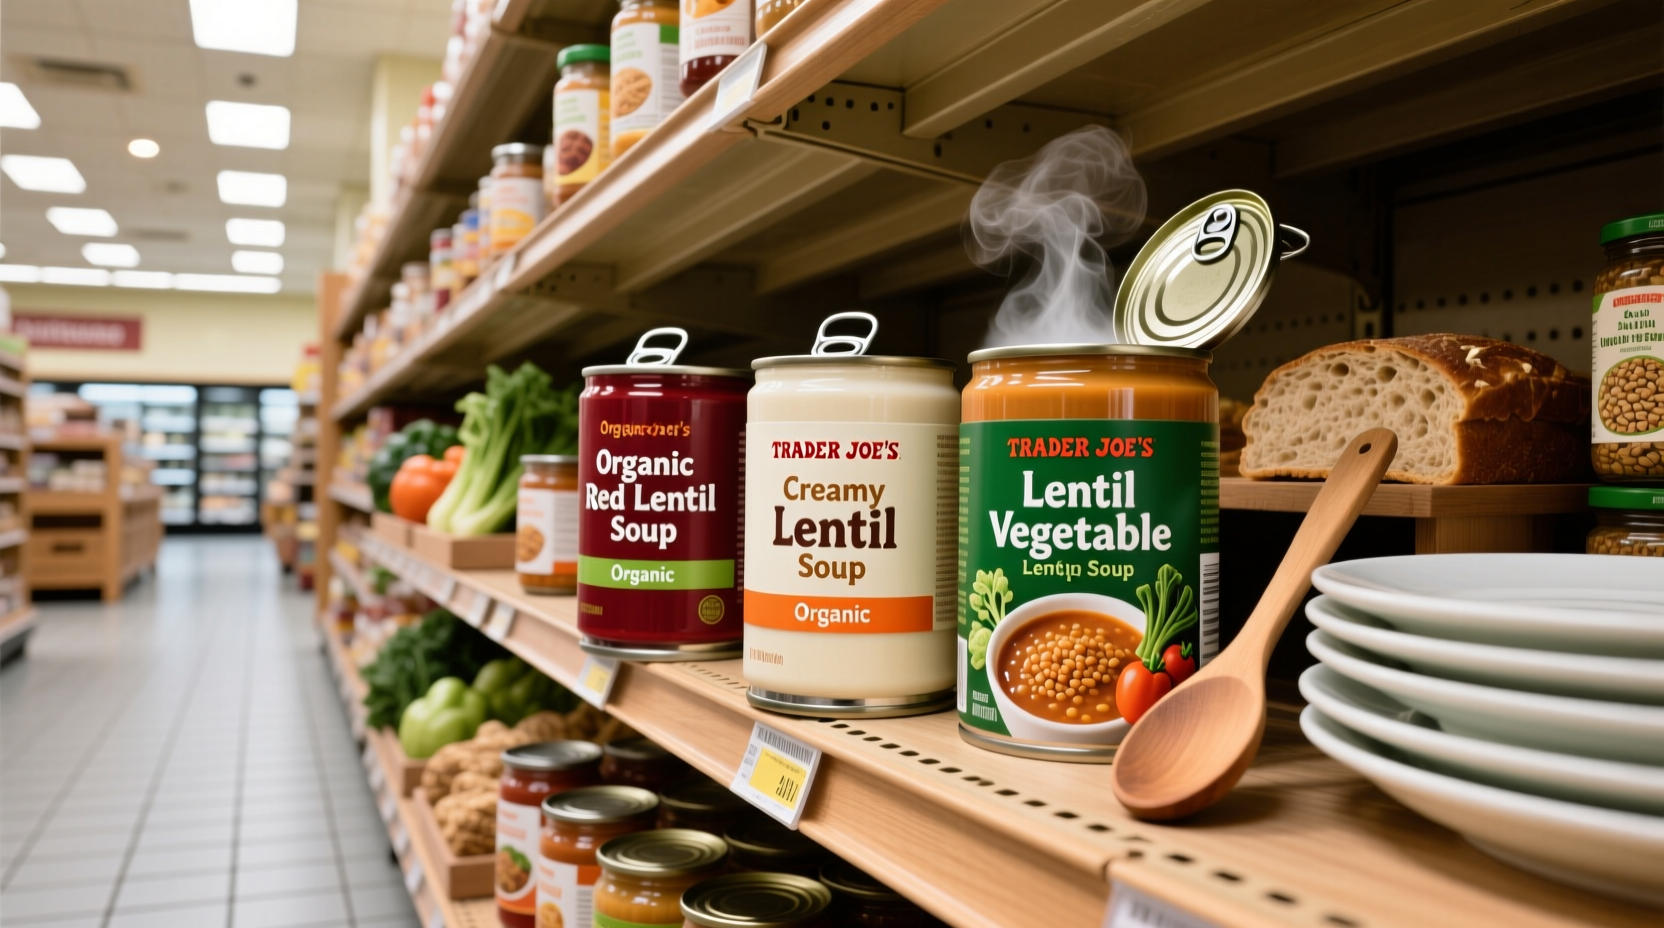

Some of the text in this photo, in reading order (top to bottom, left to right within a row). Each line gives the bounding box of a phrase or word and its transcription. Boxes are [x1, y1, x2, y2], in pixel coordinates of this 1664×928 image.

[771, 440, 899, 460] TRADER JOE'S
[1007, 437, 1154, 458] TRADER JOE'S
[596, 448, 694, 483] Organic
[585, 483, 716, 512] Red Lentil
[783, 475, 886, 509] Creamy
[1022, 470, 1135, 509] Lentil
[610, 515, 678, 550] Soup
[772, 505, 897, 549] Lentil
[989, 510, 1172, 560] Vegetable
[611, 563, 675, 586] Organic
[798, 553, 866, 586] Soup
[1087, 560, 1135, 582] Soup
[794, 602, 870, 628] Organic
